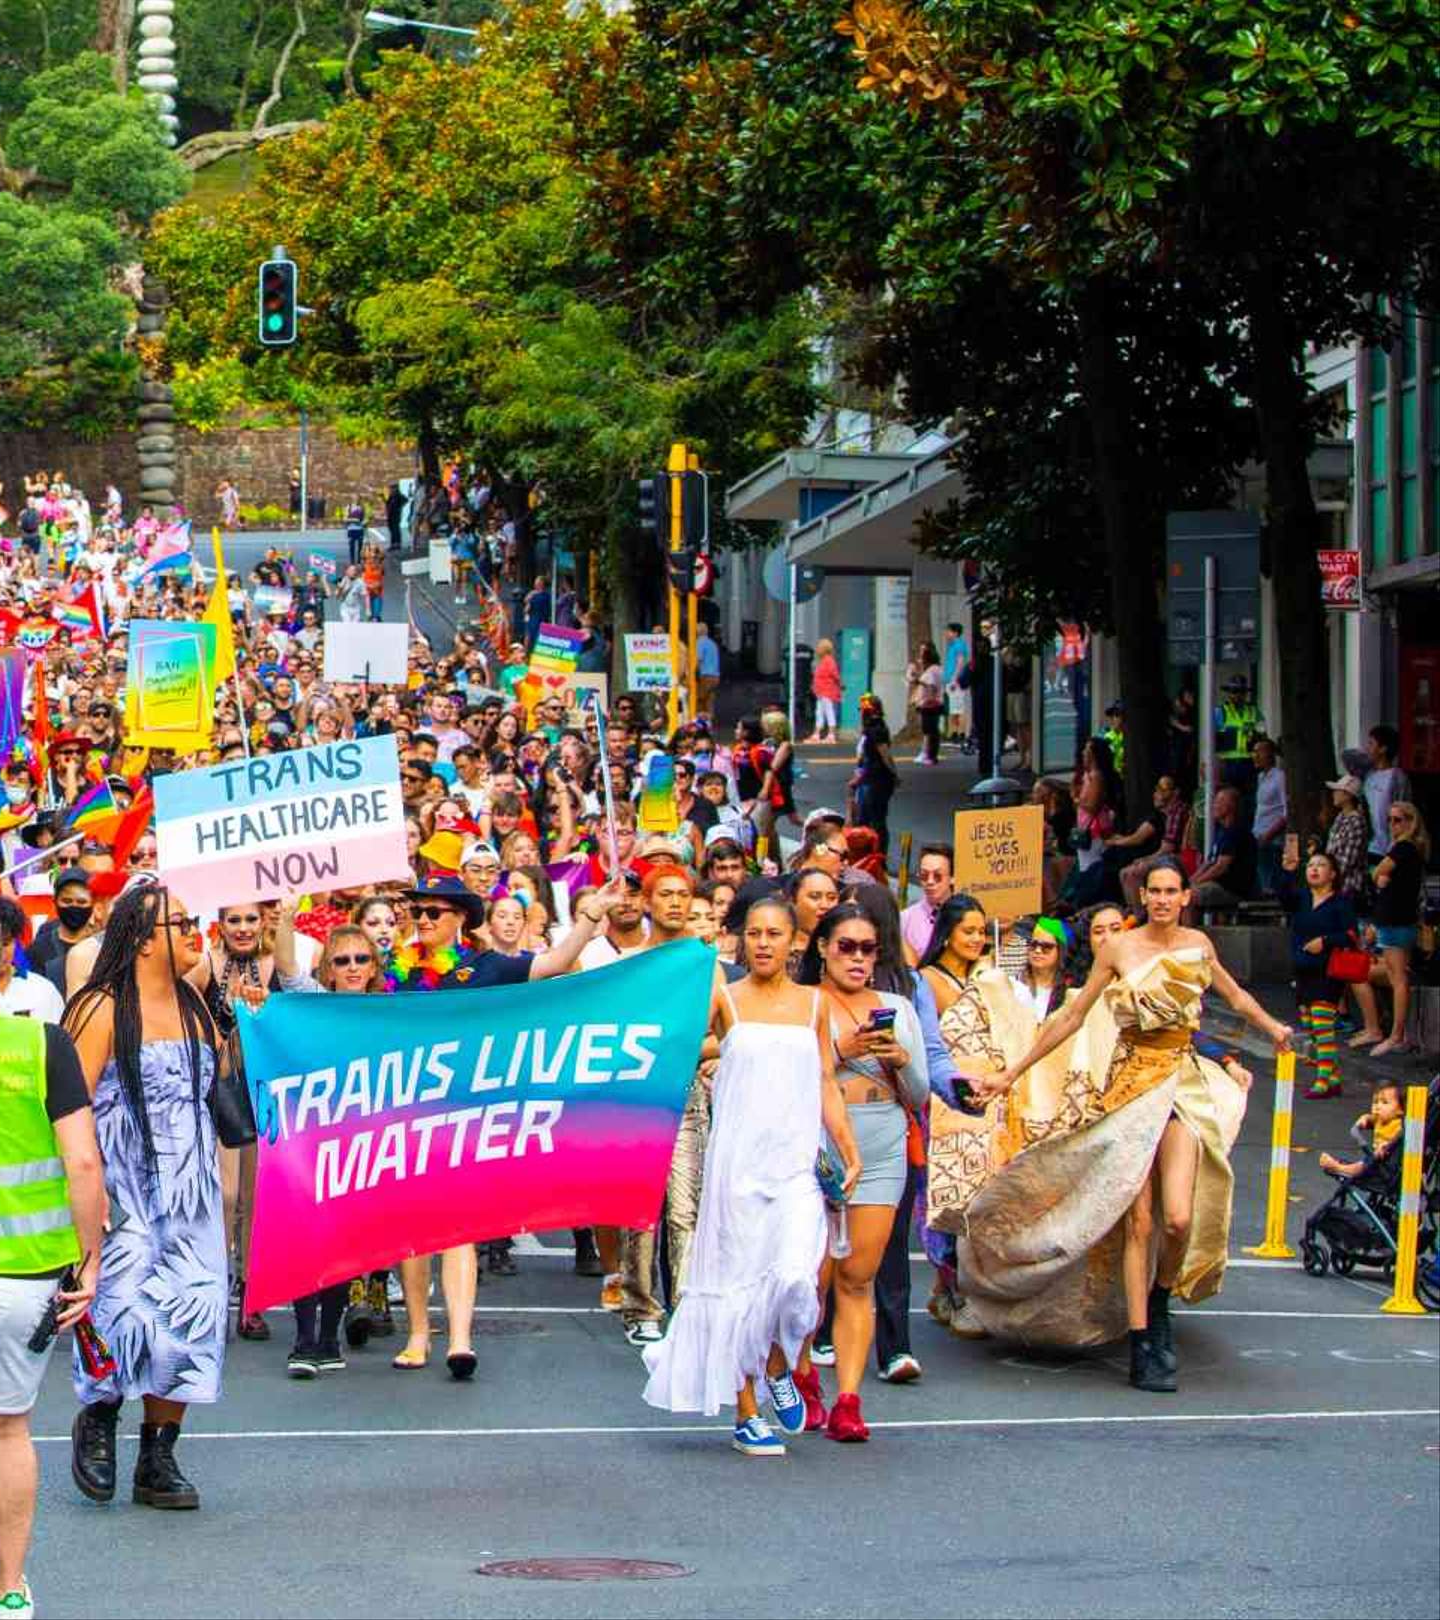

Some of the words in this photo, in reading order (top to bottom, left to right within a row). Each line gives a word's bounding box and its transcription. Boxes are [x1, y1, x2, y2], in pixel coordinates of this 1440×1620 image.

[211, 743, 363, 801] TRANS
[196, 789, 389, 853] HEALTHCARE
[970, 821, 1014, 841] JESUS
[974, 840, 1019, 858] LOVES
[254, 846, 339, 890] NOW
[269, 1040, 459, 1142] TRANS
[469, 1023, 663, 1093] LIVES
[315, 1100, 564, 1203] MATTER
